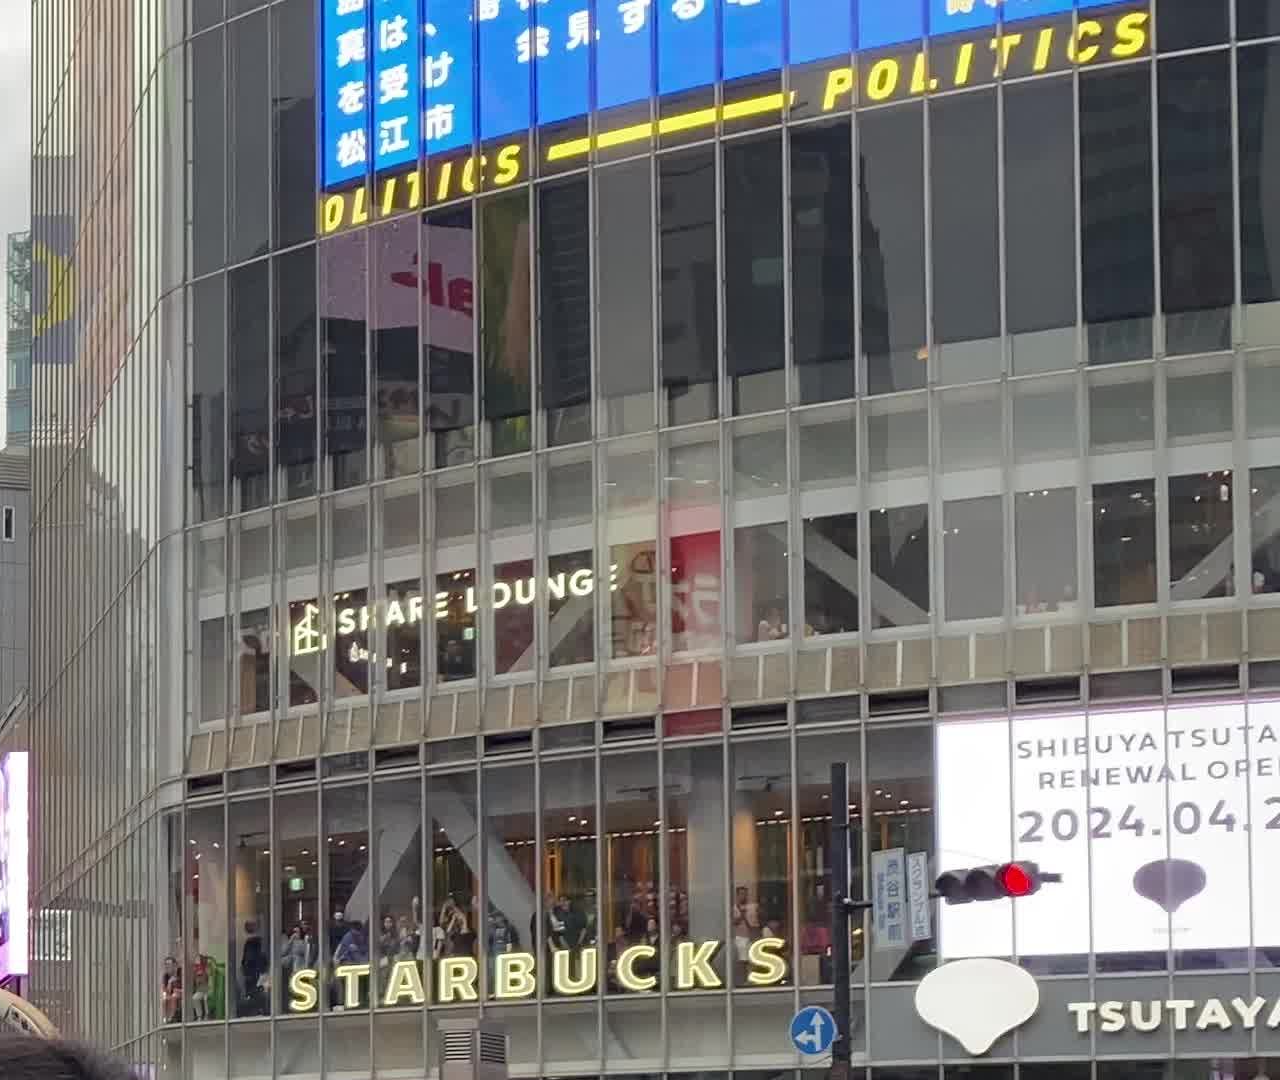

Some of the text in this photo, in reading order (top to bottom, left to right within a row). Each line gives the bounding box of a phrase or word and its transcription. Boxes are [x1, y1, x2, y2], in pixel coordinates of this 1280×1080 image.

[823, 12, 1150, 110] POLITICS
[337, 104, 454, 168] 松江市
[337, 591, 450, 636] SHARE
[1016, 731, 1158, 760] SHIBUYA
[1039, 762, 1196, 791] RENEWAL
[288, 936, 788, 1012] STARBUCKS
